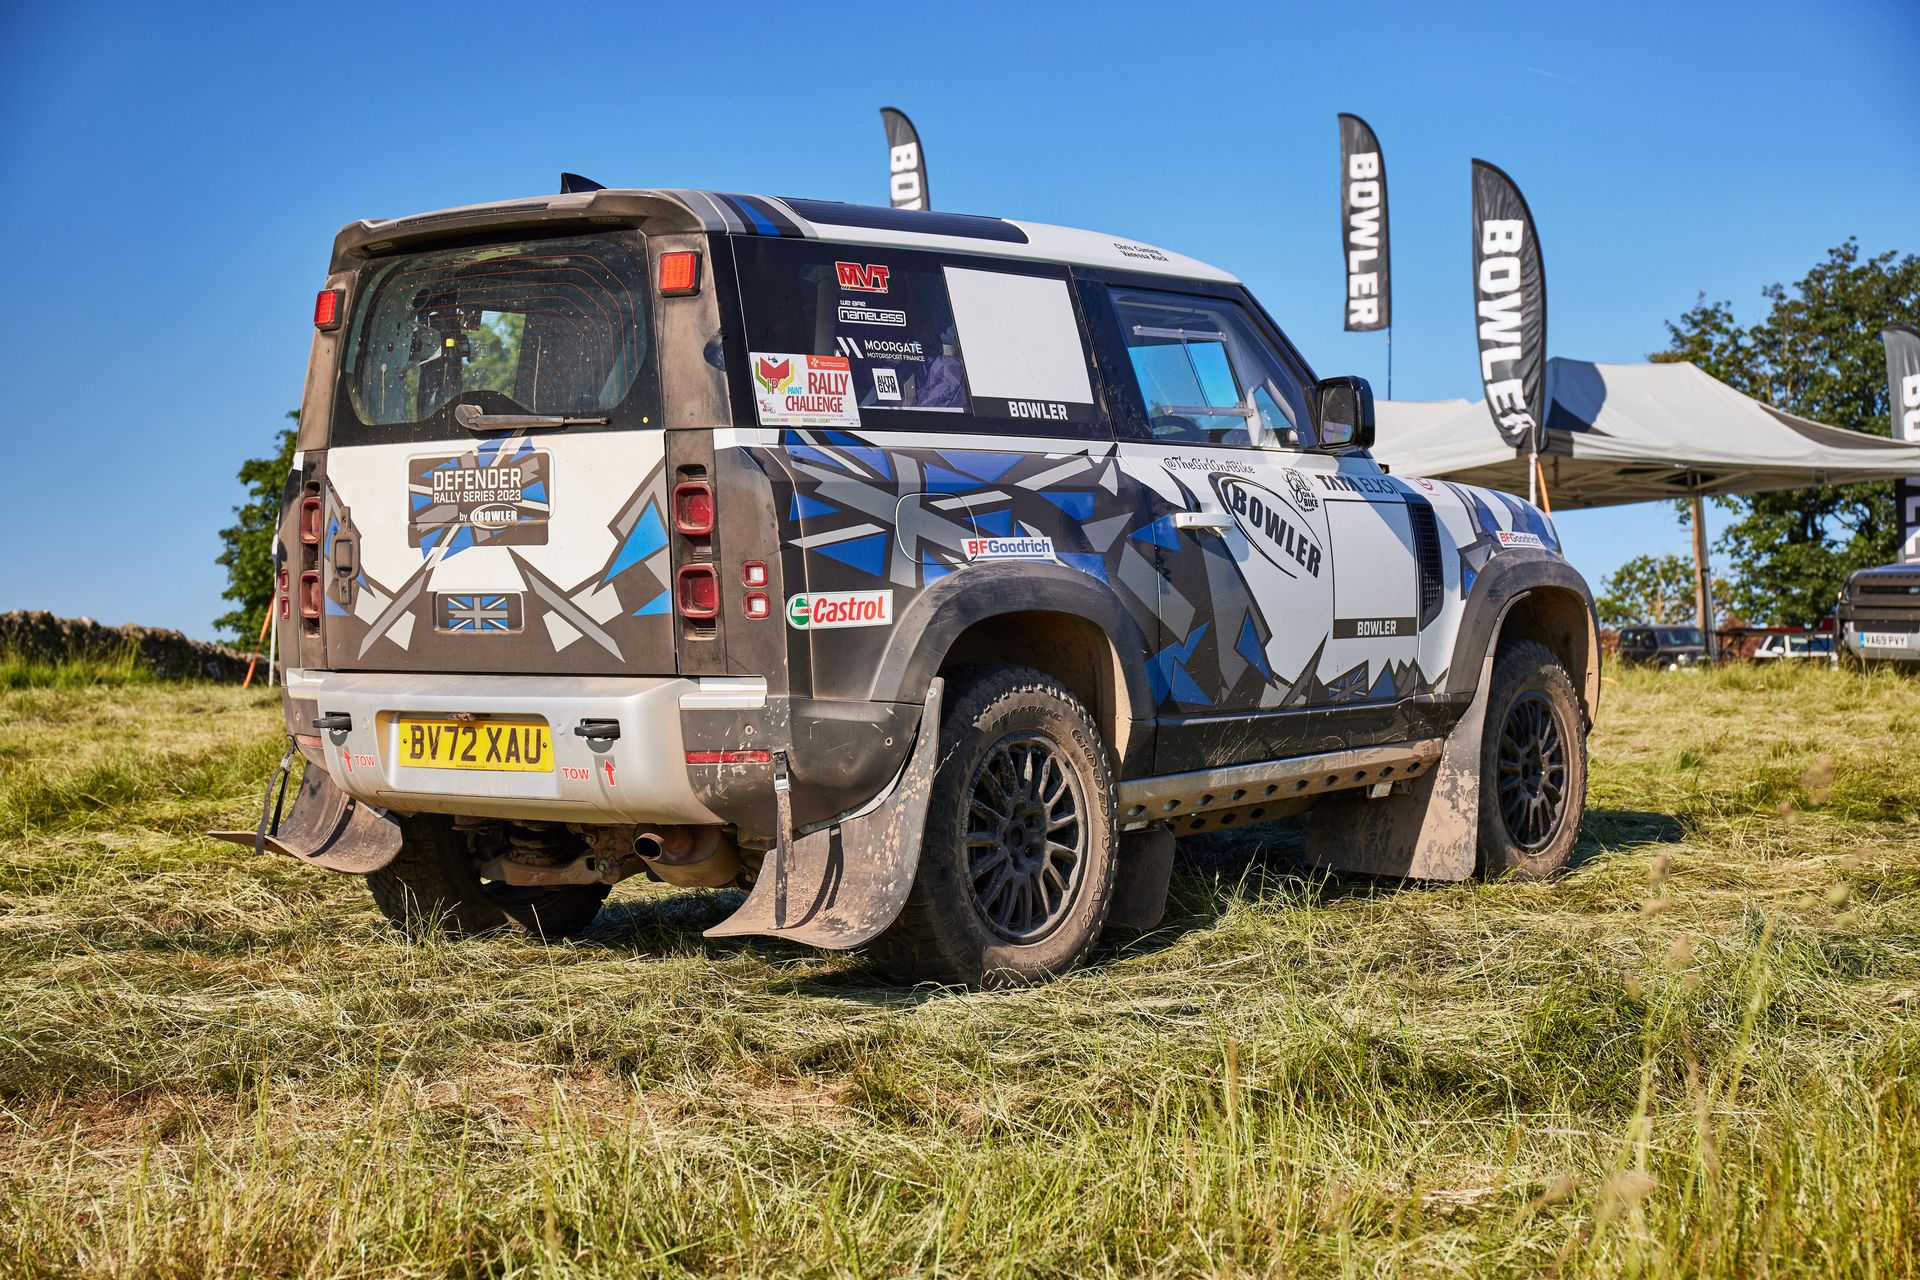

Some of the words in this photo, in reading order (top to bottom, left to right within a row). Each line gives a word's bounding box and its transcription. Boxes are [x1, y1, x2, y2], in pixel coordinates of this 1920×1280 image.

[889, 142, 922, 210] BO
[1349, 151, 1380, 326] BOWLER
[836, 262, 890, 289] MVT
[864, 340, 924, 354] MOORGATE
[867, 352, 903, 360] MOTORSPORT
[808, 372, 849, 395] RALLY
[877, 375, 896, 385] AUTO
[878, 384, 898, 393] GLYM
[787, 387, 803, 395] PAINT
[785, 396, 844, 413] CHALLENGE
[1009, 401, 1069, 421] BOWLER
[433, 468, 522, 491] DEFENDER
[1315, 475, 1359, 492] TATA
[433, 491, 462, 503] RALLY
[463, 490, 495, 503] SERIES
[497, 489, 522, 502] 2023
[1303, 498, 1319, 508] BIKE
[459, 512, 468, 523] by
[479, 510, 518, 523] BOWLER
[1231, 483, 1322, 578] BOWLER
[967, 538, 1051, 555] BFGoodrich
[813, 596, 886, 624] Castrol
[1357, 620, 1397, 636] BOWLER
[410, 725, 477, 762] BV72
[486, 727, 542, 765] XAU
[353, 755, 376, 767] TOW
[561, 767, 589, 780] TOW
